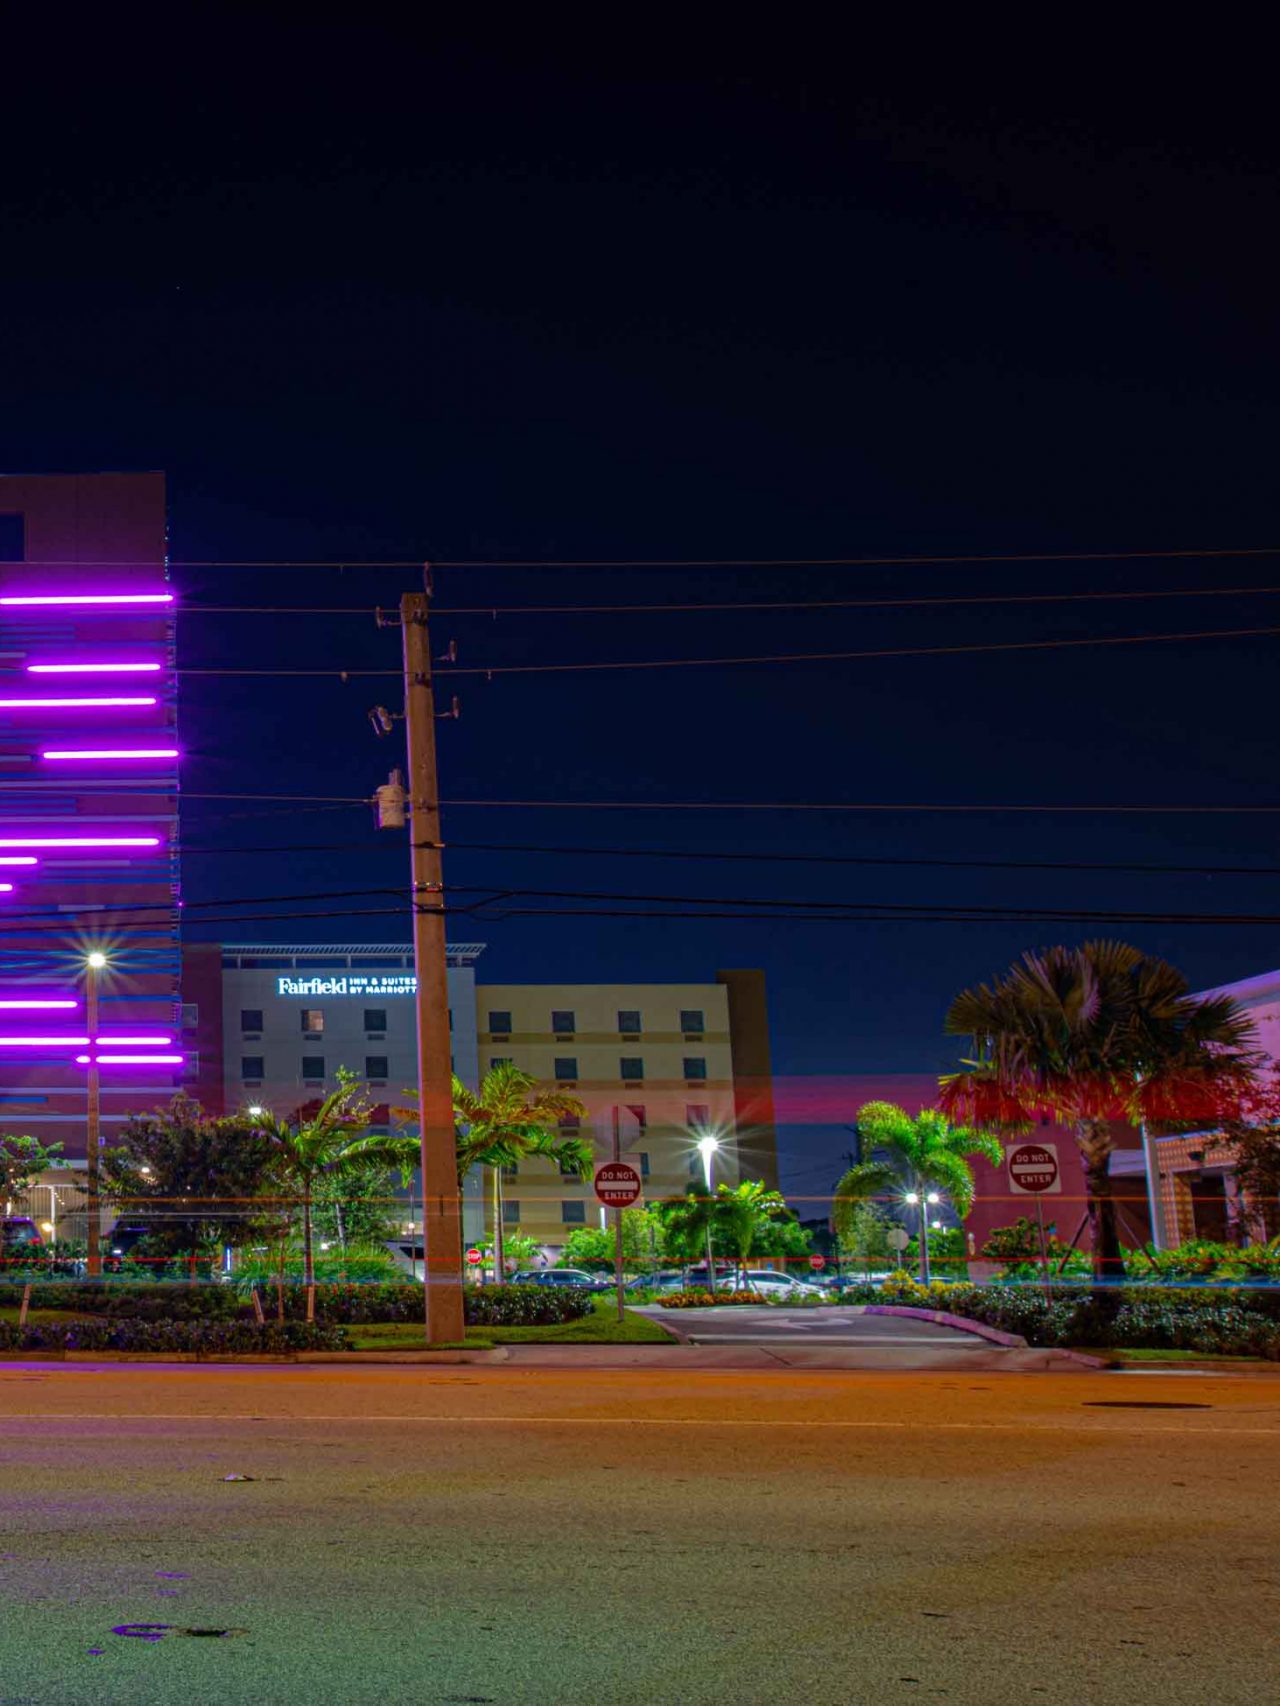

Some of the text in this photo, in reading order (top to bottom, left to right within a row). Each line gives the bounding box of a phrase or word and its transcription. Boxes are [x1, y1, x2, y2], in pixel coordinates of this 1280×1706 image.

[349, 977, 368, 985] INN
[381, 977, 417, 985] SUITES
[278, 978, 347, 995] Fairfield
[349, 986, 417, 994] BY MARRIOTT
[1016, 1154, 1049, 1163] DO NOT
[602, 1171, 634, 1180] DO NOT
[1021, 1174, 1051, 1184] ENTER
[604, 1191, 635, 1200] ENTER
